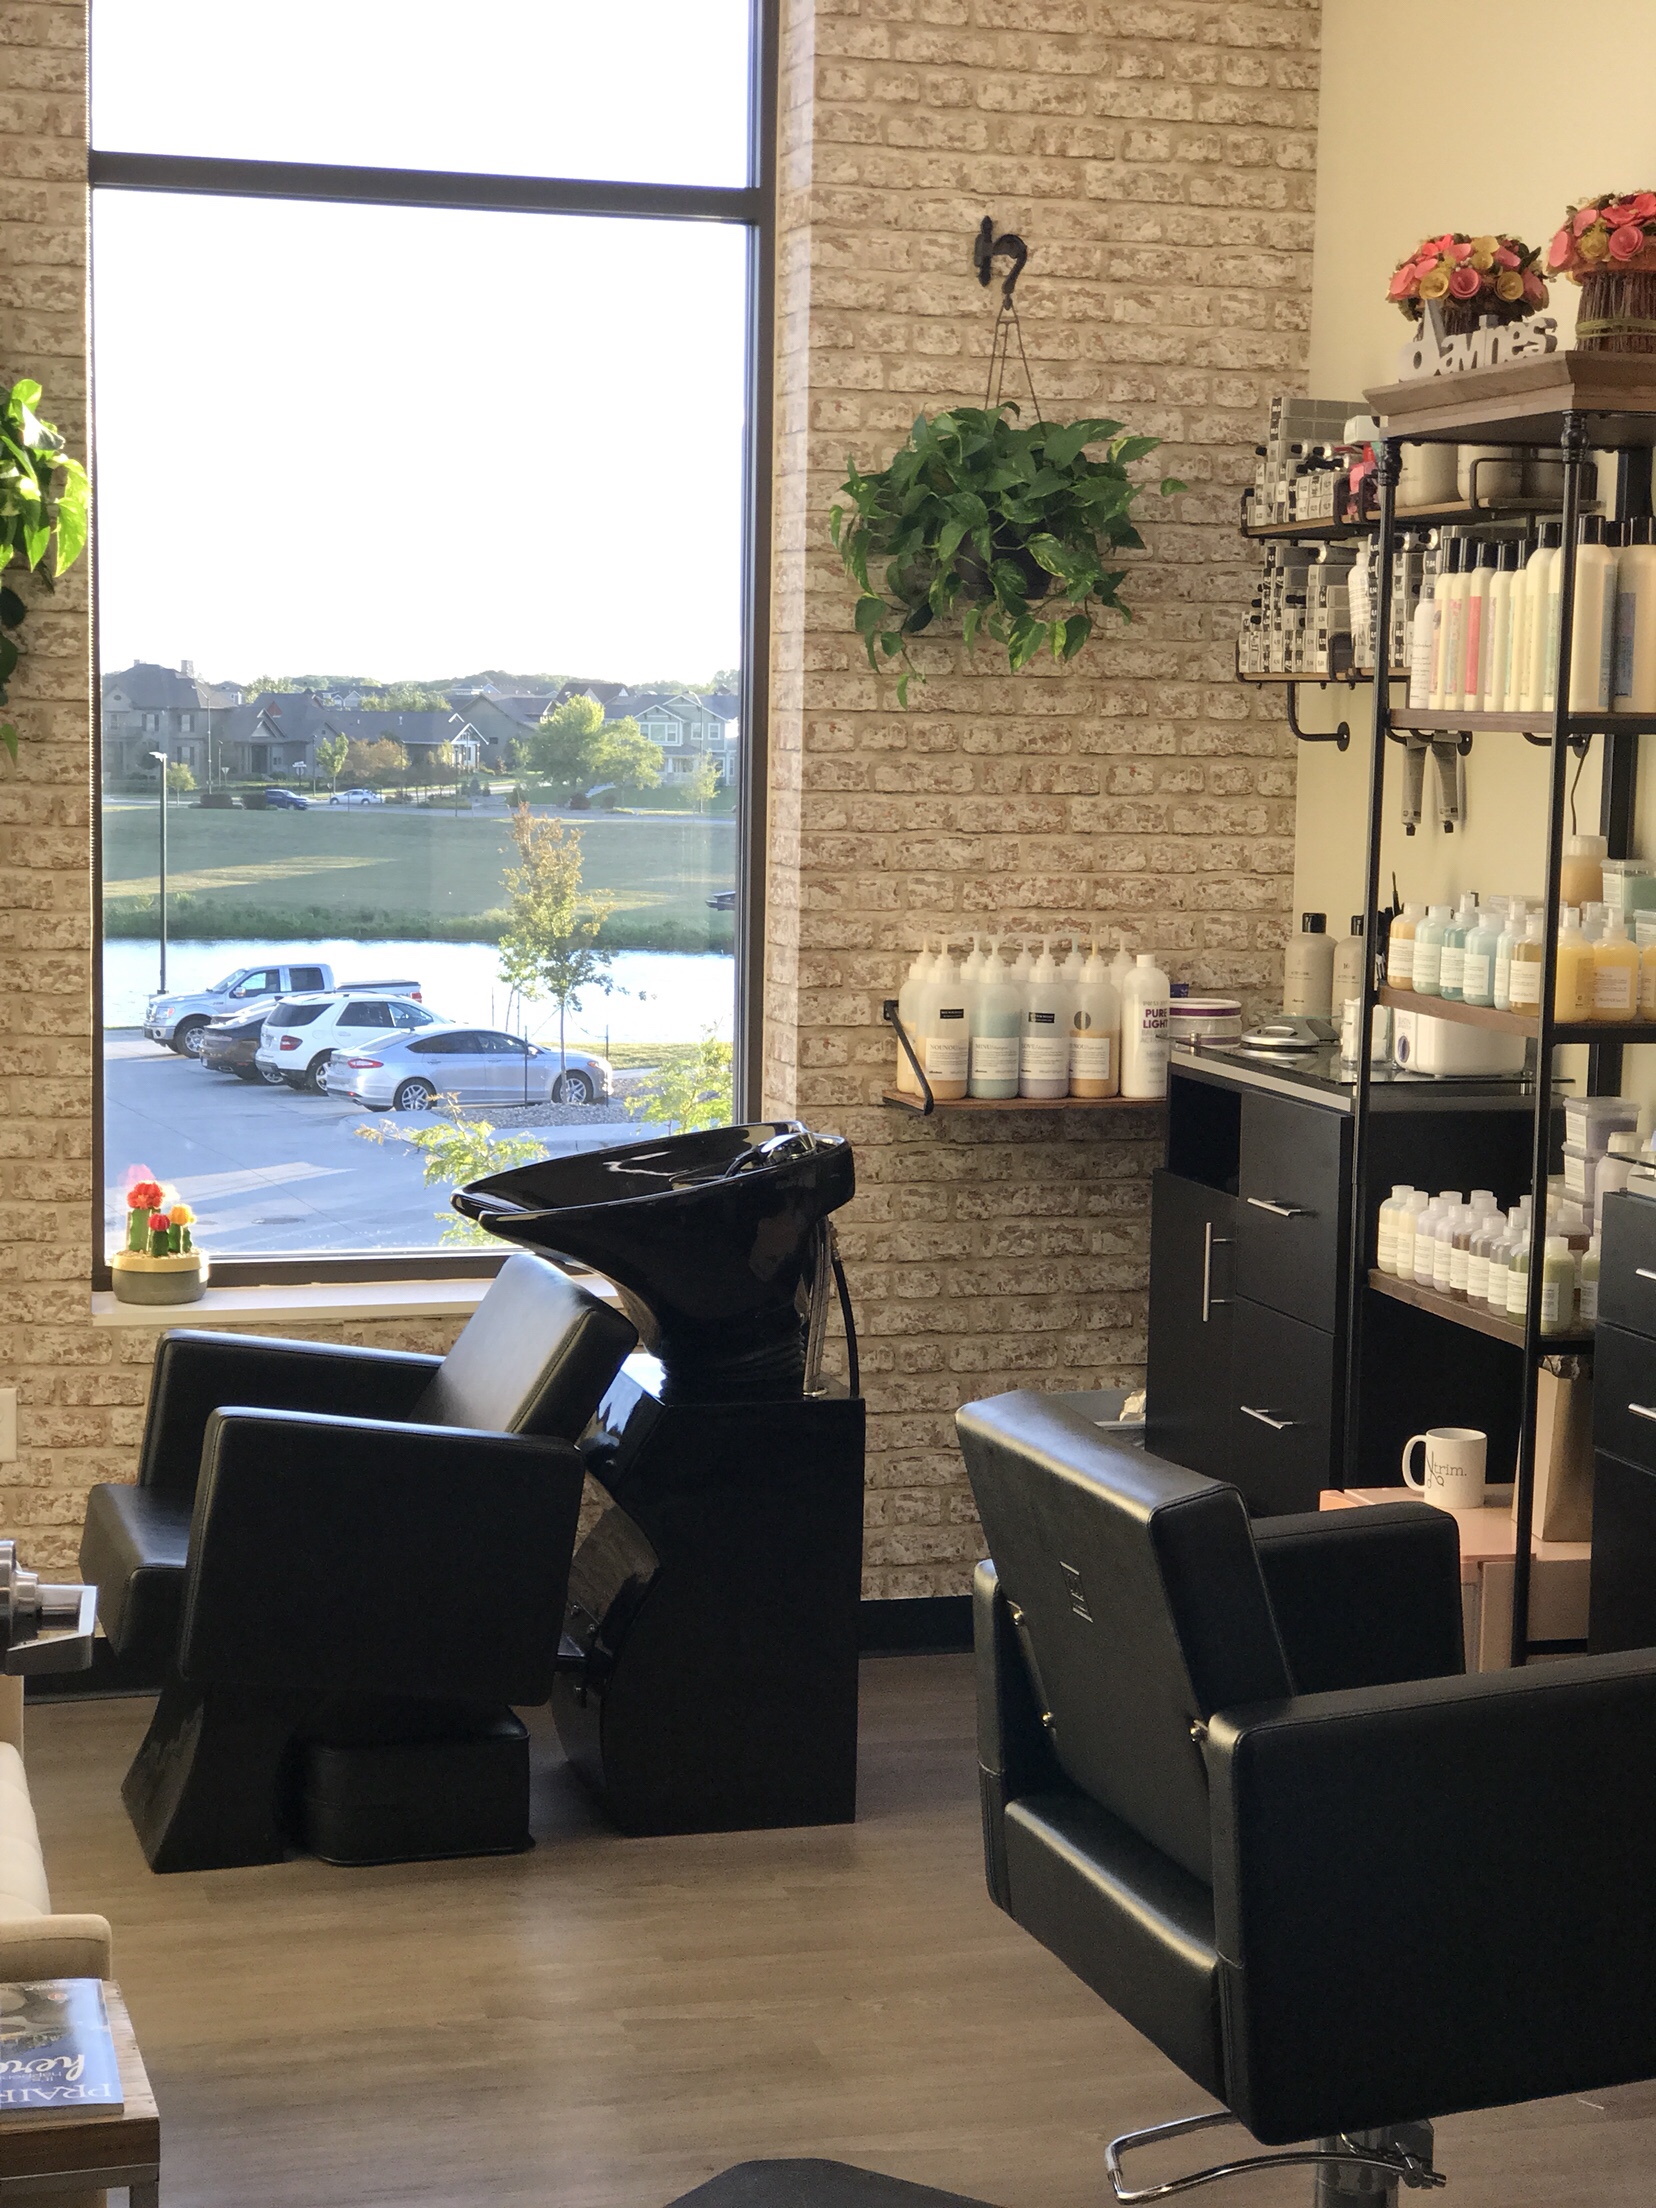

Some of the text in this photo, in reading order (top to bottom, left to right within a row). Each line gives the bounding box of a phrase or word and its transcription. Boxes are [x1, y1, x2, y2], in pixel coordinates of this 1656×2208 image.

[1398, 299, 1557, 381] davines
[1145, 1009, 1168, 1018] PURE
[1143, 1020, 1168, 1029] LIGHT
[1434, 1462, 1467, 1477] trim.
